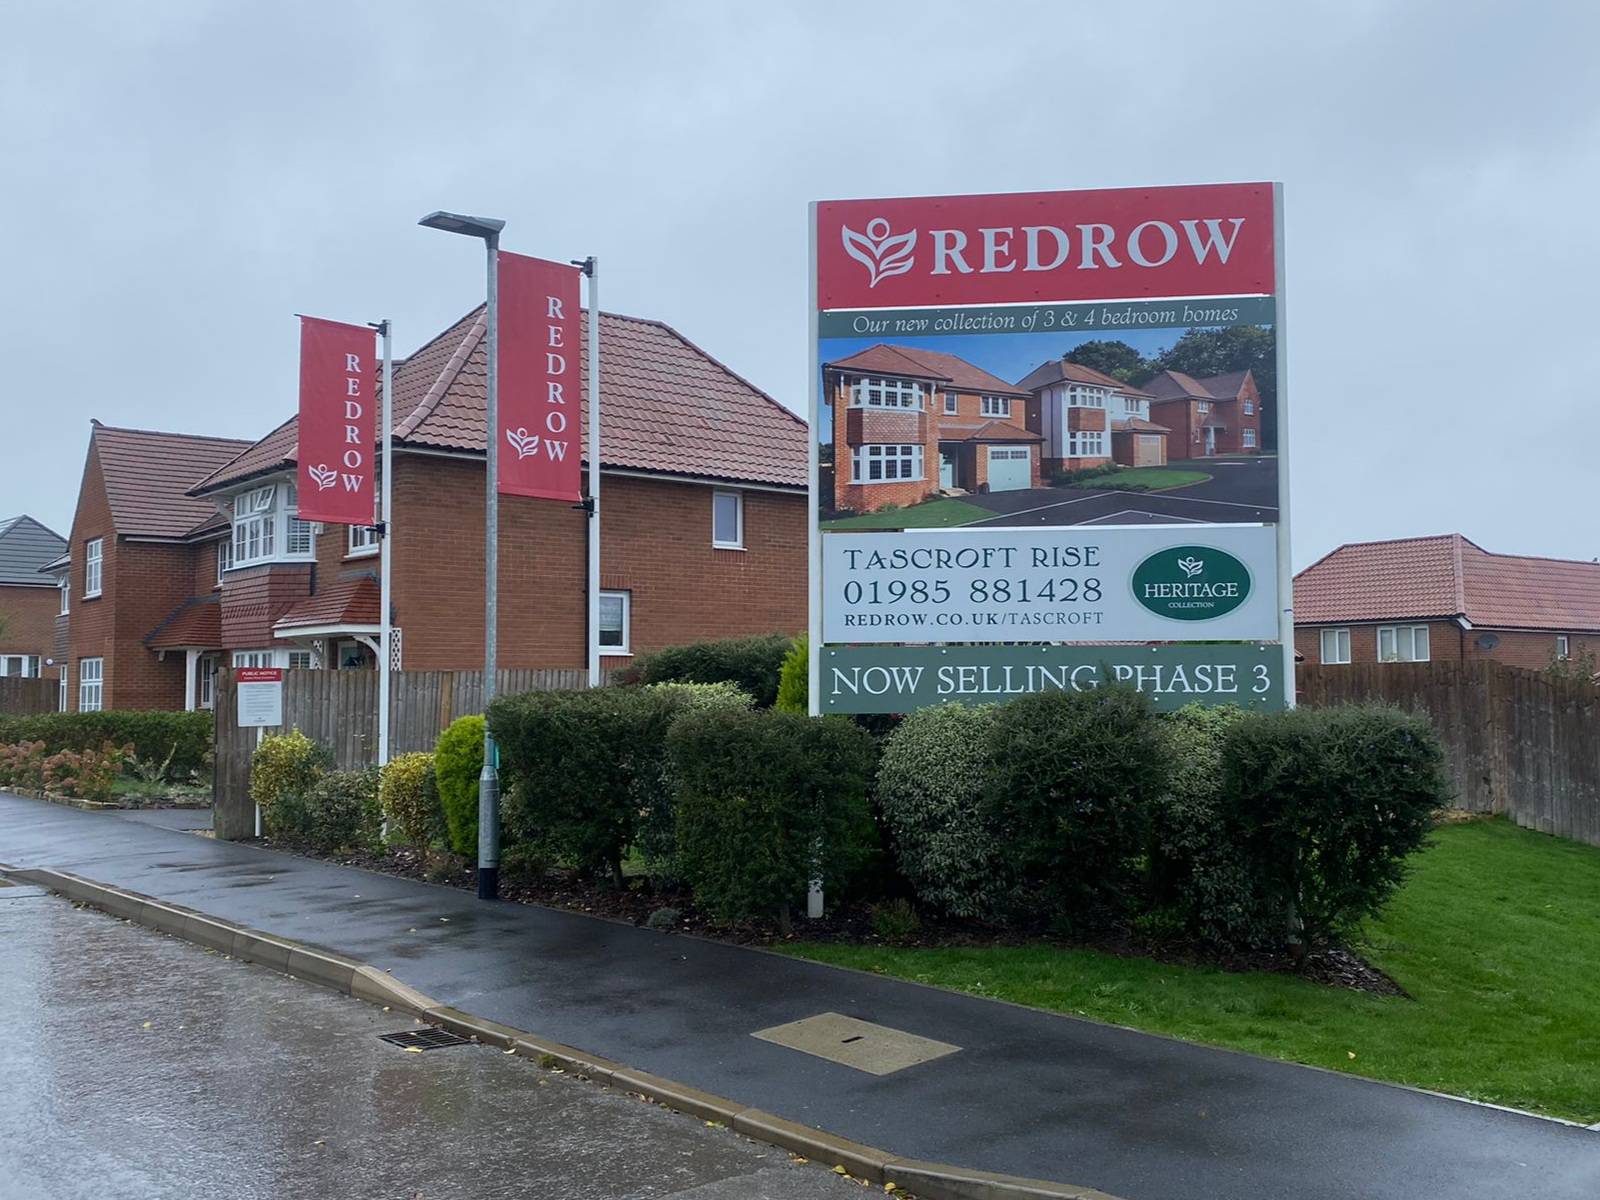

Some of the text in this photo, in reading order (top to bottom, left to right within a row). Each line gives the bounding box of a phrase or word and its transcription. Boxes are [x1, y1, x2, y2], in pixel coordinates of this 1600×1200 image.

[928, 217, 1246, 276] REDROW
[852, 305, 1239, 333] Our new collection of 3 & 4 bedroom homes
[544, 295, 568, 463] REDROW
[341, 353, 364, 493] REDROW
[843, 546, 1100, 571] TASCROFT RISE
[843, 578, 1103, 604] 01985 881428
[1144, 582, 1239, 598] HERITAGE
[1168, 601, 1215, 609] COLLECTION
[844, 611, 1104, 627] REDROW.CO.UK/TASCROFT
[831, 664, 1271, 695] NOW SELLING PHASE 3
